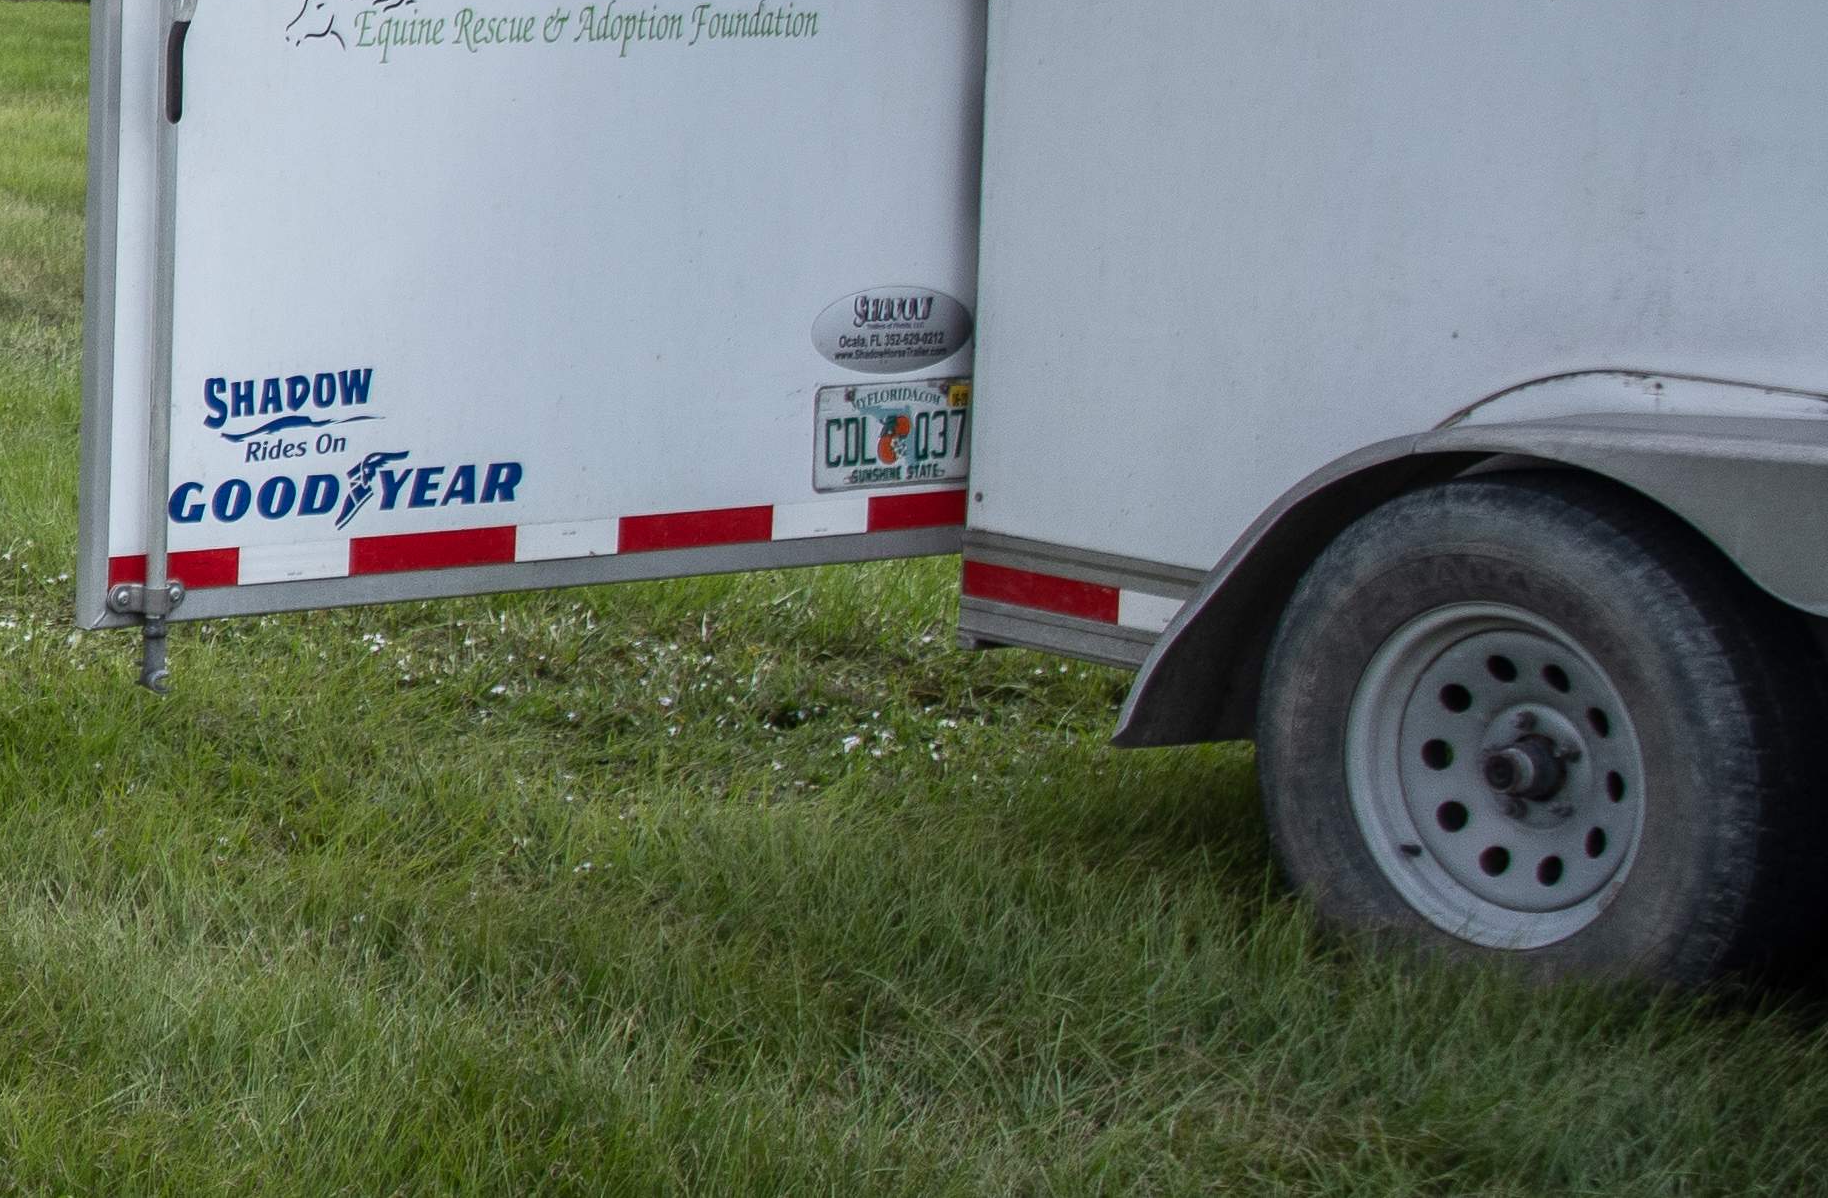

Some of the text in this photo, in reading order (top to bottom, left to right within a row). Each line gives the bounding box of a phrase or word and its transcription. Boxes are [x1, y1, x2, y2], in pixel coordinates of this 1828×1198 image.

[354, 7, 445, 64] Equine
[453, 7, 535, 53] Rescue
[543, 8, 570, 43] &
[573, 0, 684, 58] Adoption
[869, 333, 882, 346] FL
[203, 368, 373, 429] SHADOW
[244, 433, 347, 464] Rides On
[825, 417, 877, 468] CDL
[906, 463, 939, 480] STATE
